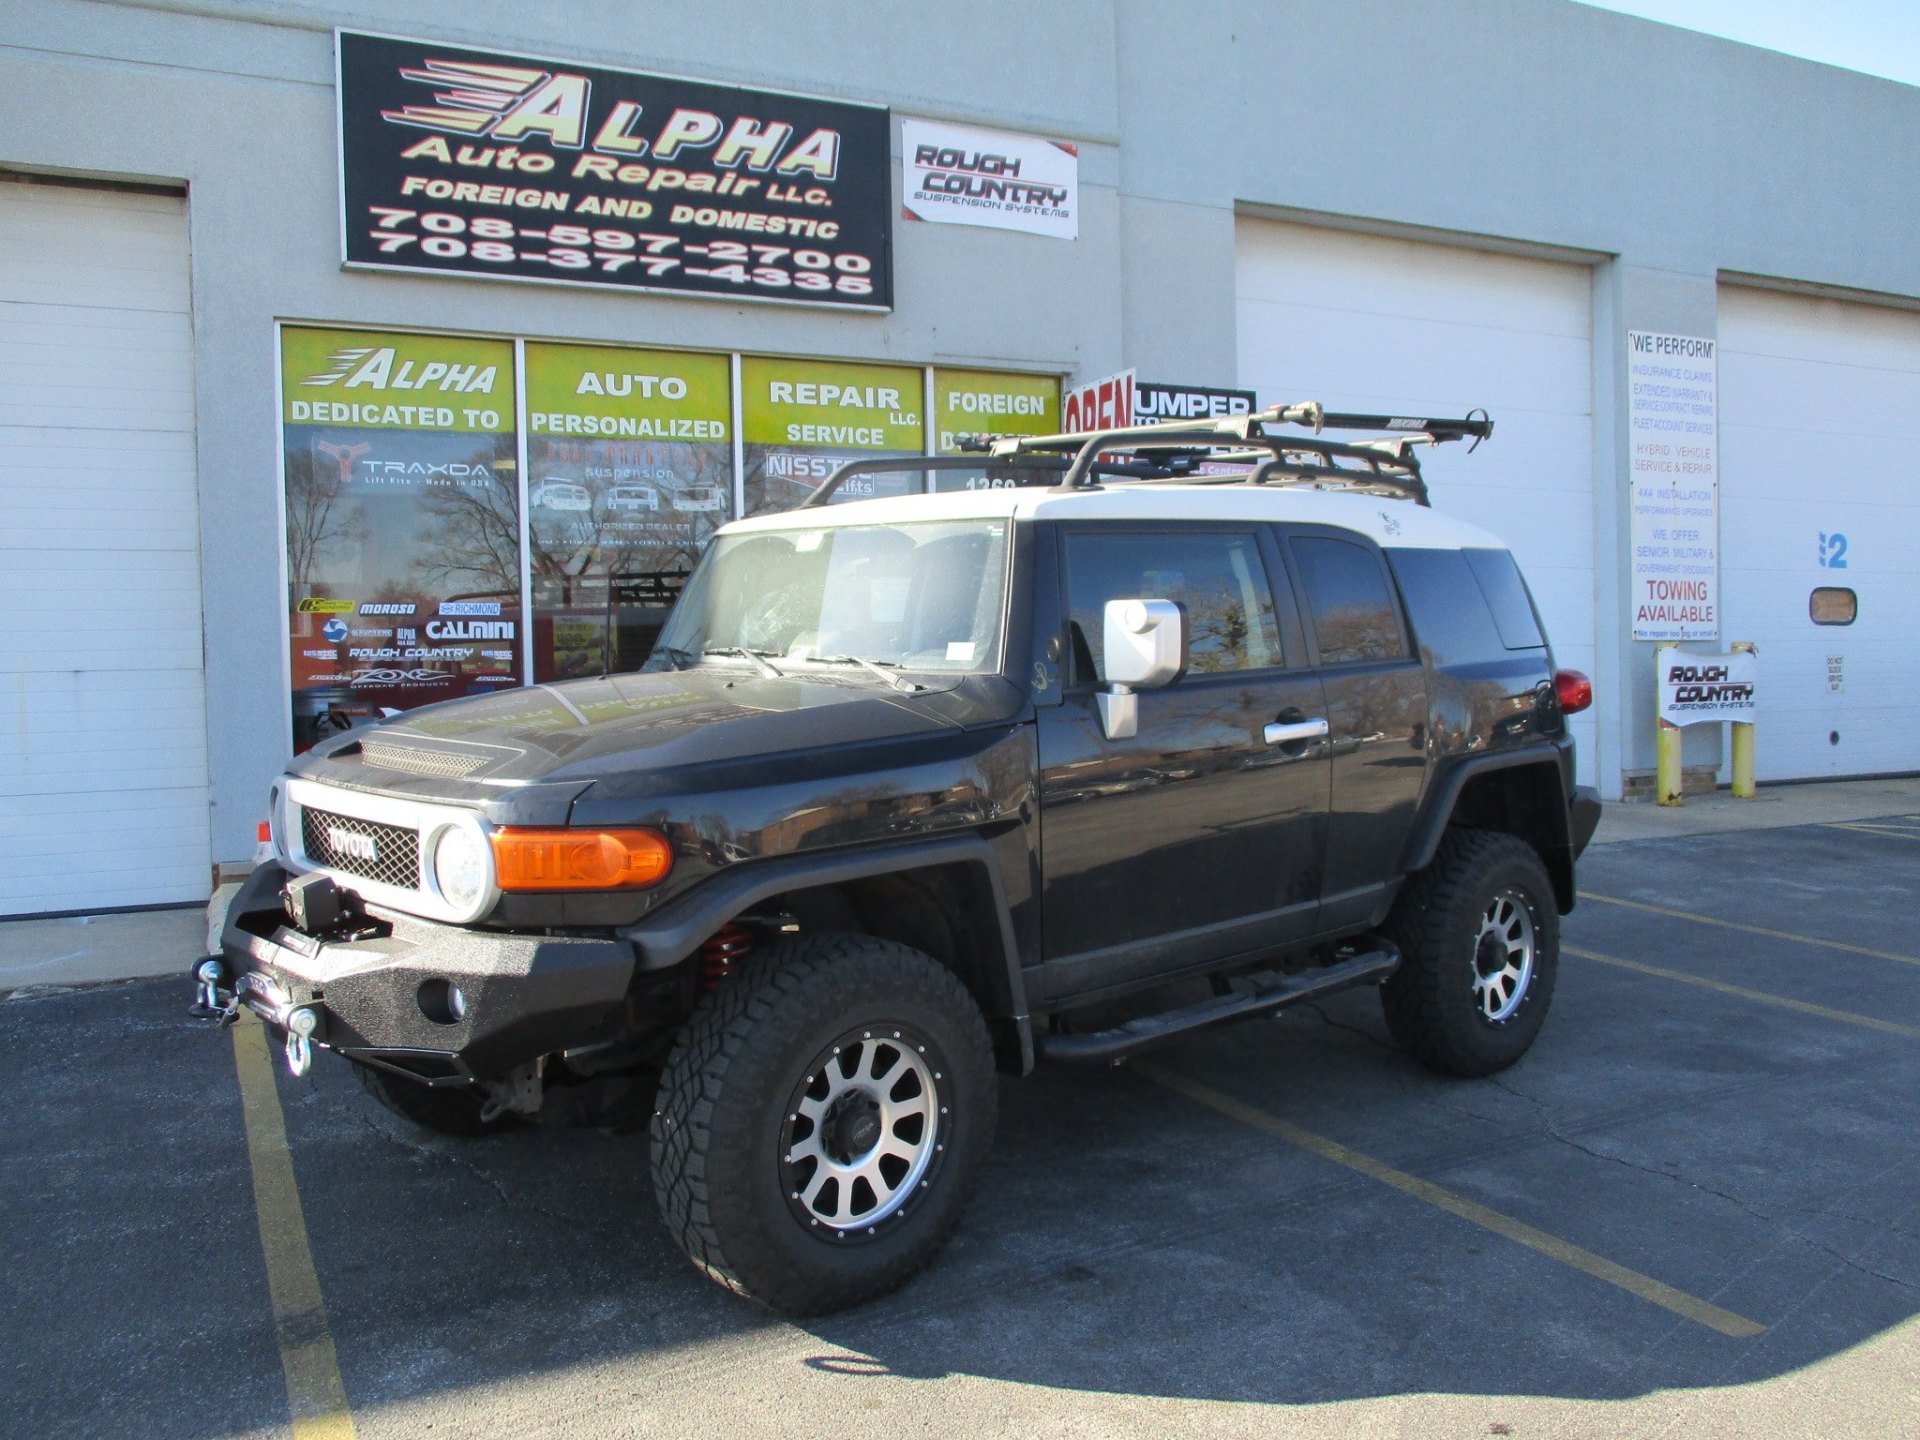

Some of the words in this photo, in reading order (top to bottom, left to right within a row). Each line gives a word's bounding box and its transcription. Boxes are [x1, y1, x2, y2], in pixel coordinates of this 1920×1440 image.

[490, 72, 840, 180] ALPHA
[401, 135, 555, 172] Auto
[571, 154, 760, 191] Repair
[766, 184, 832, 206] LLC.
[915, 144, 1021, 177] ROUGH
[922, 172, 1067, 208] COUNTRY
[401, 176, 569, 211] FOREIGN
[575, 195, 652, 219] AND
[670, 205, 839, 239] DOMESTIC
[914, 191, 1000, 209] SUSPENSION
[1005, 202, 1069, 218] SYSTEMS
[368, 206, 871, 272] 708-597-2700
[369, 231, 873, 294] 708-377-4335
[1633, 334, 1653, 353] WE
[1656, 337, 1712, 359] PERFORM
[344, 348, 496, 393] ALPHA
[1633, 365, 1681, 379] INSURANCE
[1684, 369, 1712, 382] CLAIMS
[577, 372, 687, 399] AUTO
[770, 381, 900, 409] REPAIR
[292, 401, 454, 426] DEDICATED
[463, 410, 499, 428] TO
[949, 392, 1044, 415] FOREIGN
[1135, 390, 1249, 417] UMPER
[532, 413, 725, 438] PERSONALIZED
[889, 412, 921, 426] LLC.
[787, 424, 884, 445] SERVICE
[1637, 444, 1669, 456] HYBRID
[1676, 447, 1710, 459] VEHICLE
[362, 461, 489, 476] TRAXDA
[585, 467, 673, 479] suspension
[1635, 459, 1672, 472] SERVICE
[1675, 462, 1680, 472] &
[1683, 462, 1711, 473] REPAIR
[1658, 489, 1711, 501] INSTALLATION
[1653, 529, 1666, 540] WE
[1671, 530, 1699, 540] OFFER
[1647, 580, 1707, 601] TOWING
[360, 603, 416, 614] MOROSO
[455, 604, 499, 614] RICHMOND
[1637, 605, 1713, 622] AVAILABLE
[426, 621, 514, 639] CALMINI
[349, 648, 400, 657] ROUGH
[405, 648, 474, 657] COUNTRY
[1669, 666, 1728, 682] ROUGH
[1675, 685, 1754, 702] COUNTRY
[328, 827, 378, 862] TOYOTA
